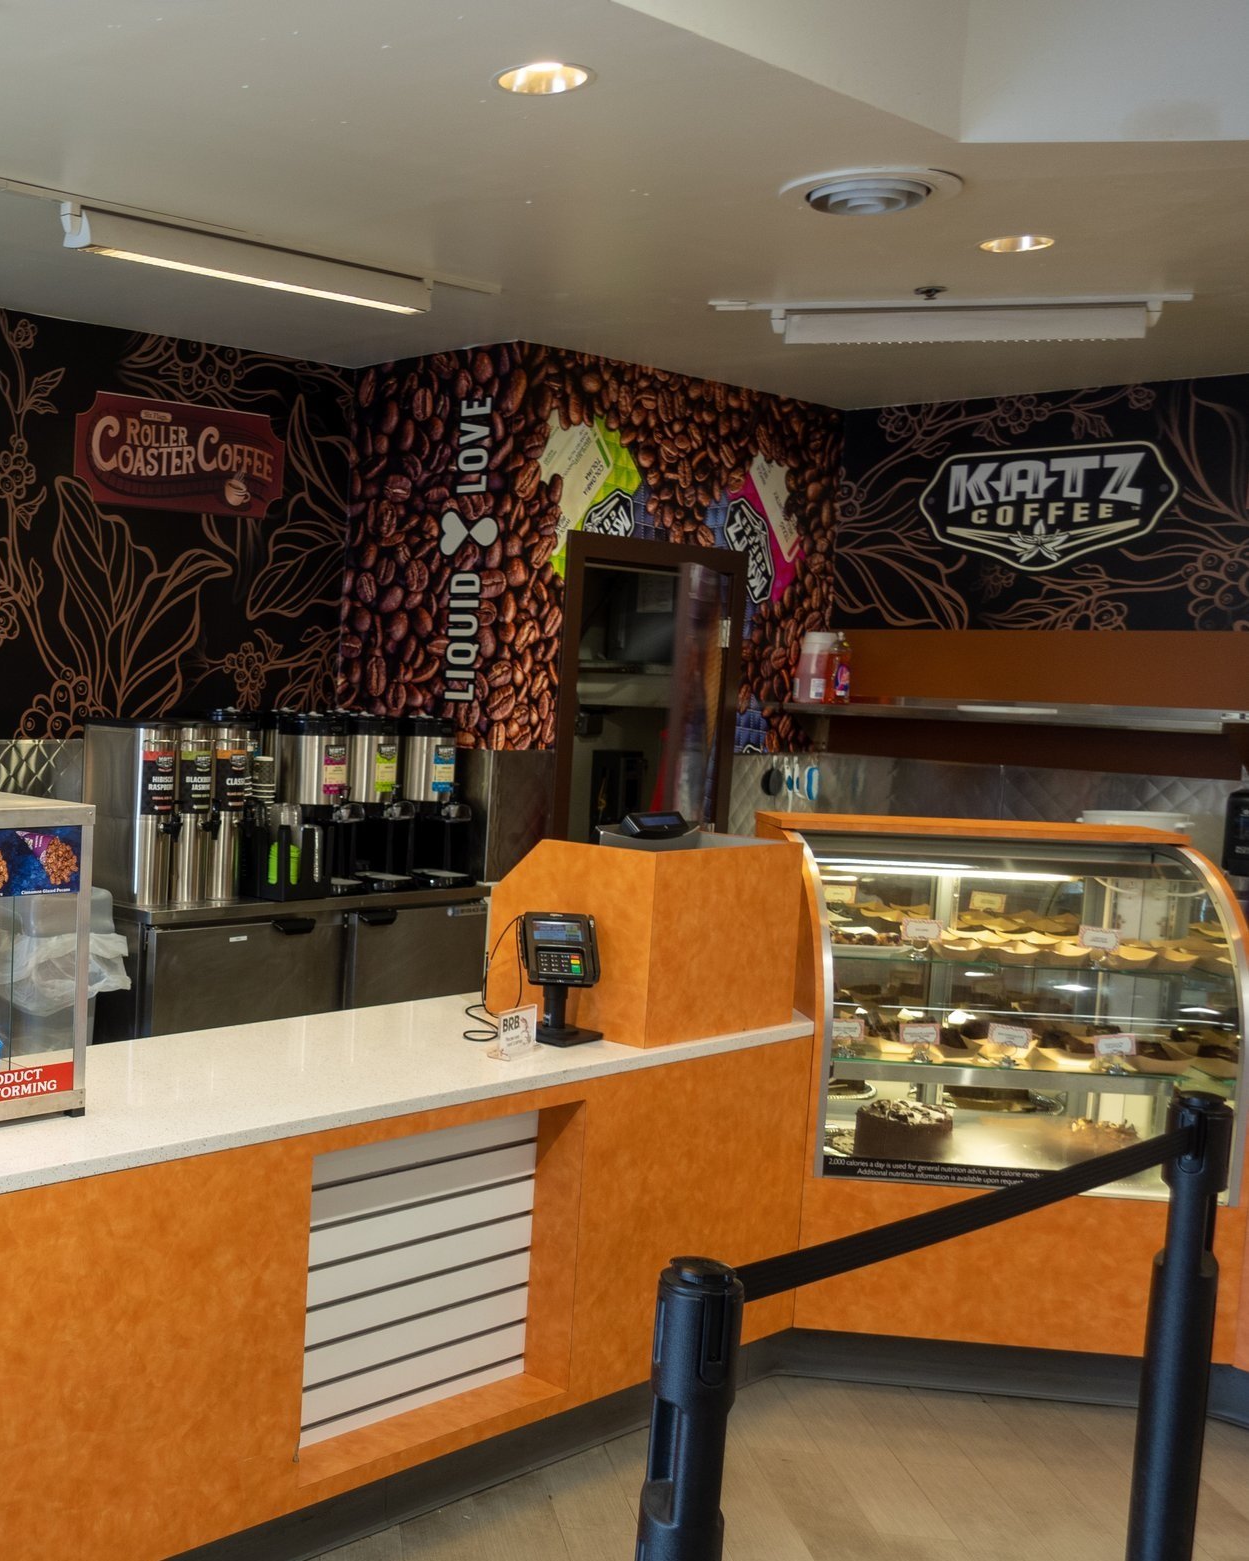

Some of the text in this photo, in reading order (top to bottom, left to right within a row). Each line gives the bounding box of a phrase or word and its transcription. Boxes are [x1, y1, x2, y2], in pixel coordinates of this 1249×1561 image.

[126, 417, 188, 447] ROLLER
[456, 397, 492, 493] LOVE
[91, 415, 275, 482] COASTER COFFEE
[948, 452, 1146, 514] KATZ
[971, 502, 1114, 527] COFFEE
[444, 573, 482, 700] LIQUID
[503, 1015, 520, 1033] BRB
[846, 1160, 869, 1168] calories
[874, 1162, 885, 1170] day
[917, 1164, 940, 1173] general
[940, 1166, 967, 1174] nutrition
[989, 1169, 1000, 1177] but
[1000, 1170, 1021, 1178] calorie
[856, 1167, 887, 1177] Additional
[888, 1170, 914, 1178] nutrition
[915, 1171, 950, 1180] information
[956, 1174, 982, 1183] available
[982, 1177, 999, 1185] upon
